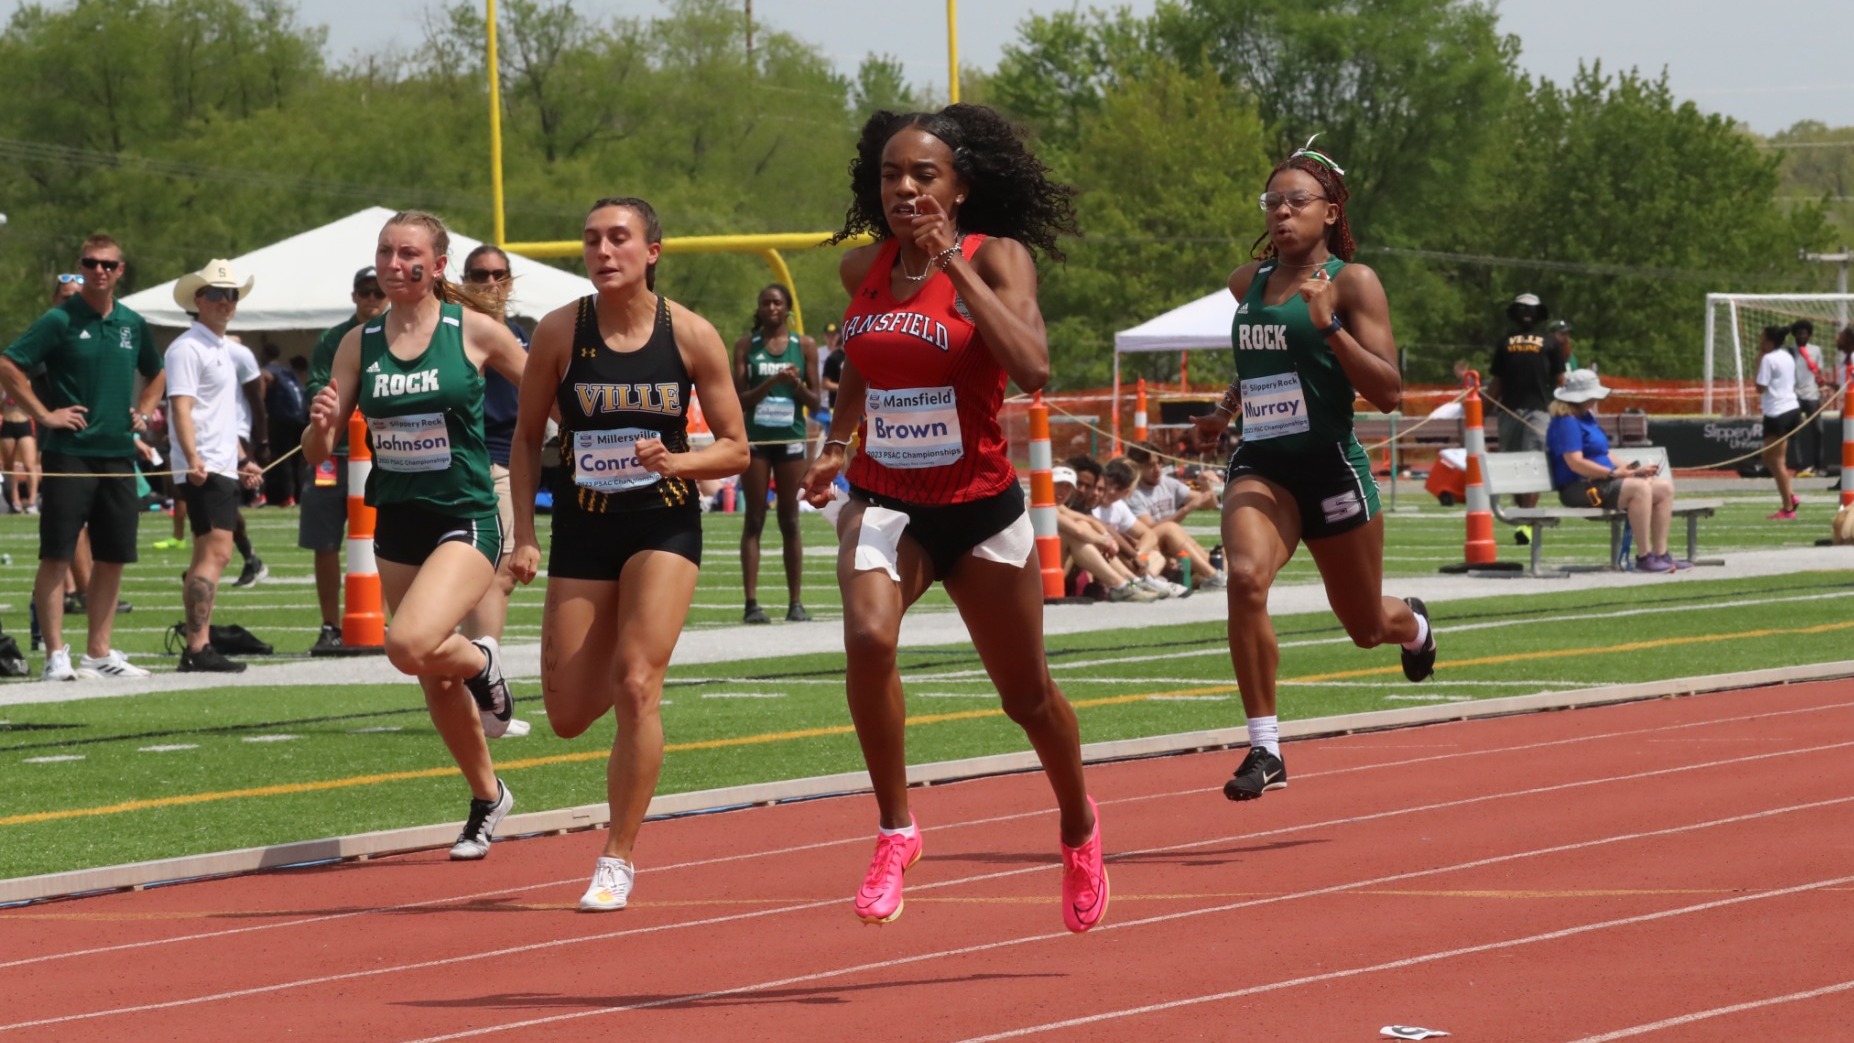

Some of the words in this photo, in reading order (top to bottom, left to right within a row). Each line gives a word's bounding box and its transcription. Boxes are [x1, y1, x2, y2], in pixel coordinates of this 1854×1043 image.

[218, 267, 227, 278] S
[1238, 324, 1288, 351] ROCK
[373, 368, 440, 398] ROCK
[1249, 381, 1277, 392] Slippery
[1278, 378, 1298, 387] Rock
[574, 382, 682, 417] VILLE
[884, 390, 952, 408] Mansfield
[1244, 399, 1300, 419] Murray
[389, 420, 420, 429] Slippery
[421, 418, 442, 426] Rock
[875, 416, 948, 439] Brown
[376, 434, 447, 451] Johnson
[597, 430, 658, 445] Millersville
[883, 451, 901, 459] PSAC
[902, 448, 962, 460] Championships
